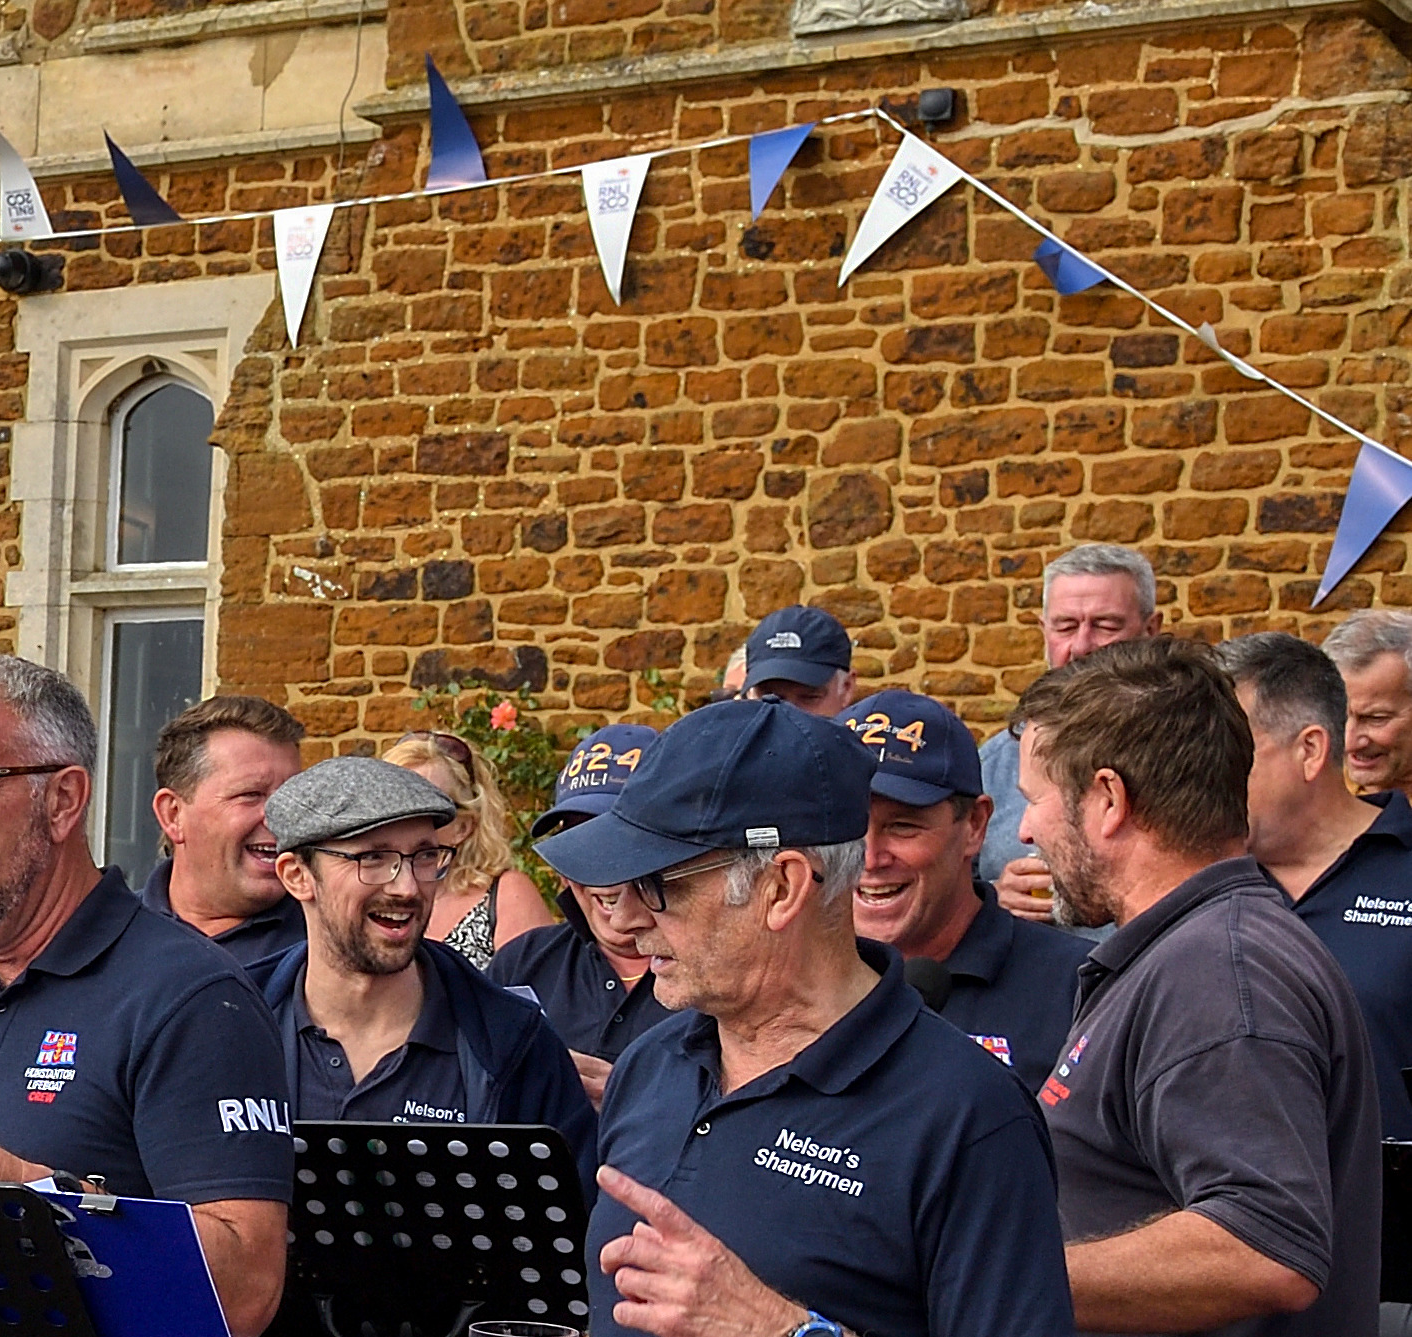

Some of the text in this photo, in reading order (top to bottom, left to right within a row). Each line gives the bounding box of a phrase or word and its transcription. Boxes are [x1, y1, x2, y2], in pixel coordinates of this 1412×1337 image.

[560, 743, 642, 785] 1824
[570, 772, 608, 790] RNLI
[1343, 909, 1412, 926] Shantyme
[24, 1067, 76, 1080] HUNSTANTON
[27, 1079, 65, 1091] LIFEBOAT
[404, 1100, 465, 1122] Nelson's
[775, 1128, 860, 1169] Nelson's
[754, 1148, 864, 1197] Shantymen
